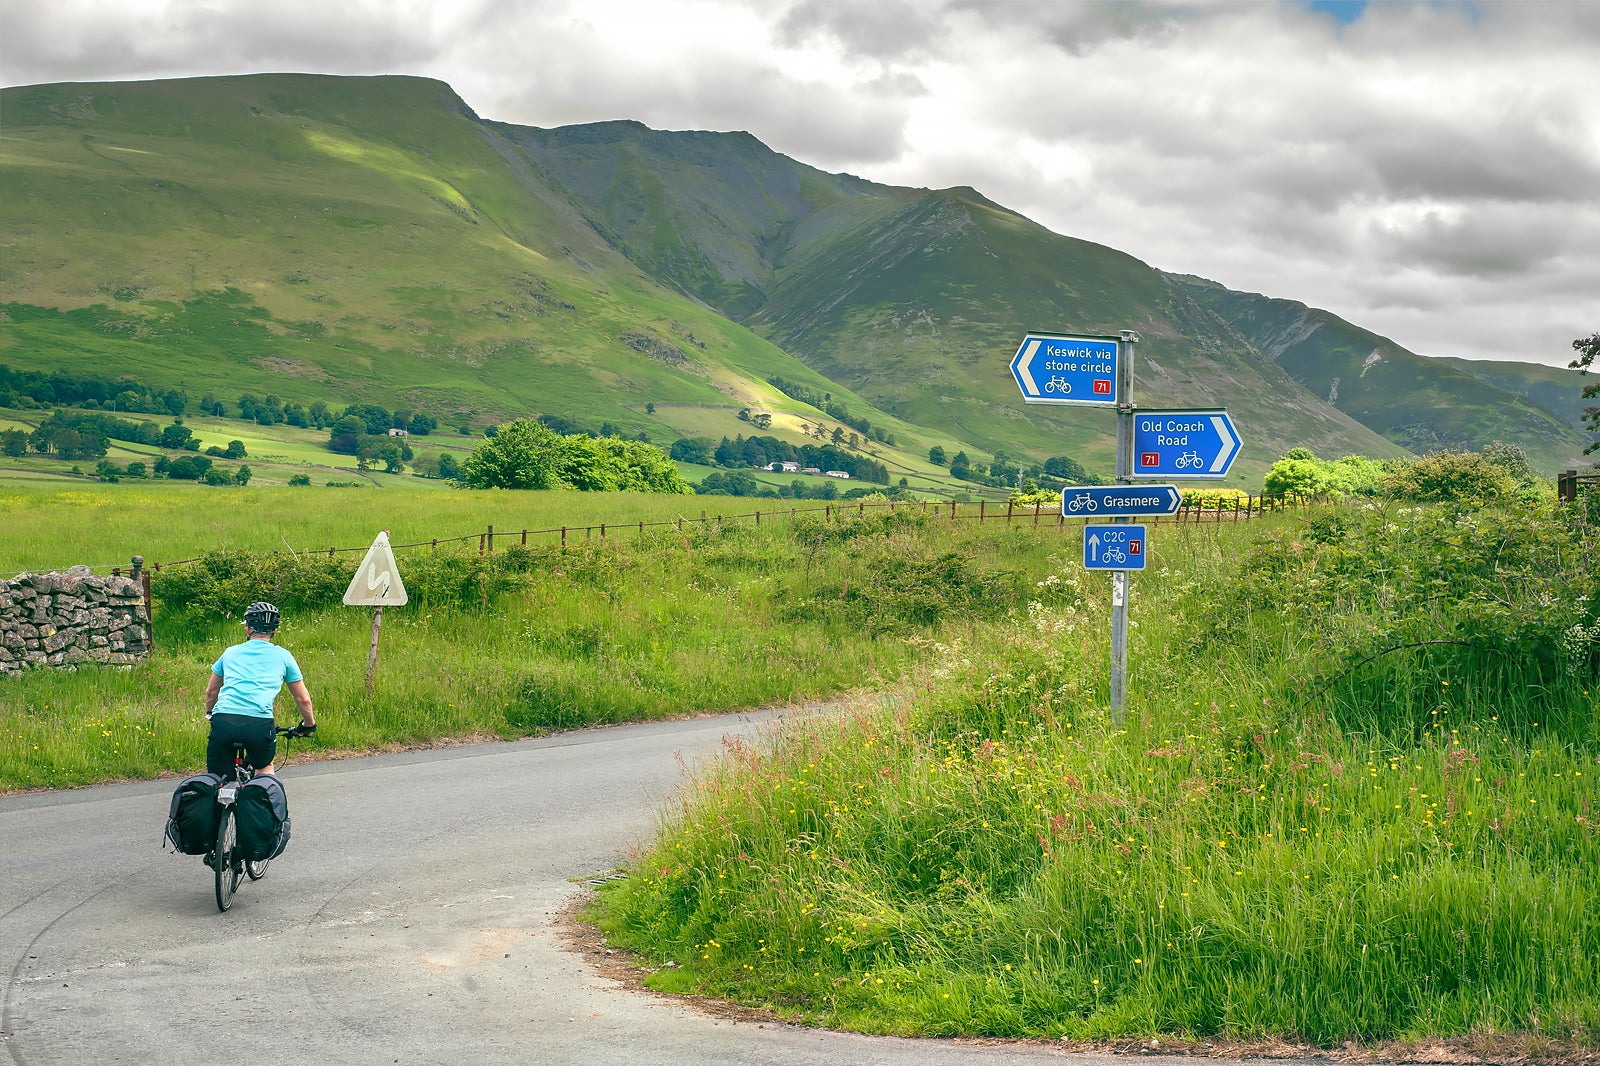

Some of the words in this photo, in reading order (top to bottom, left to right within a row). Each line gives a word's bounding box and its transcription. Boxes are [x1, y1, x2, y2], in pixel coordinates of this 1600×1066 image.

[1046, 345, 1092, 359] Keswick
[1095, 348, 1112, 360] via
[1045, 359, 1077, 372] stone
[1080, 361, 1112, 374] circle
[1097, 382, 1107, 392] 71
[1141, 420, 1162, 432] Old
[1166, 420, 1205, 432] Coach
[1157, 434, 1188, 446] Road
[1145, 455, 1155, 465] 71
[1103, 495, 1160, 507] Grasmere
[1103, 531, 1126, 543] C2C
[1130, 542, 1139, 552] 71
